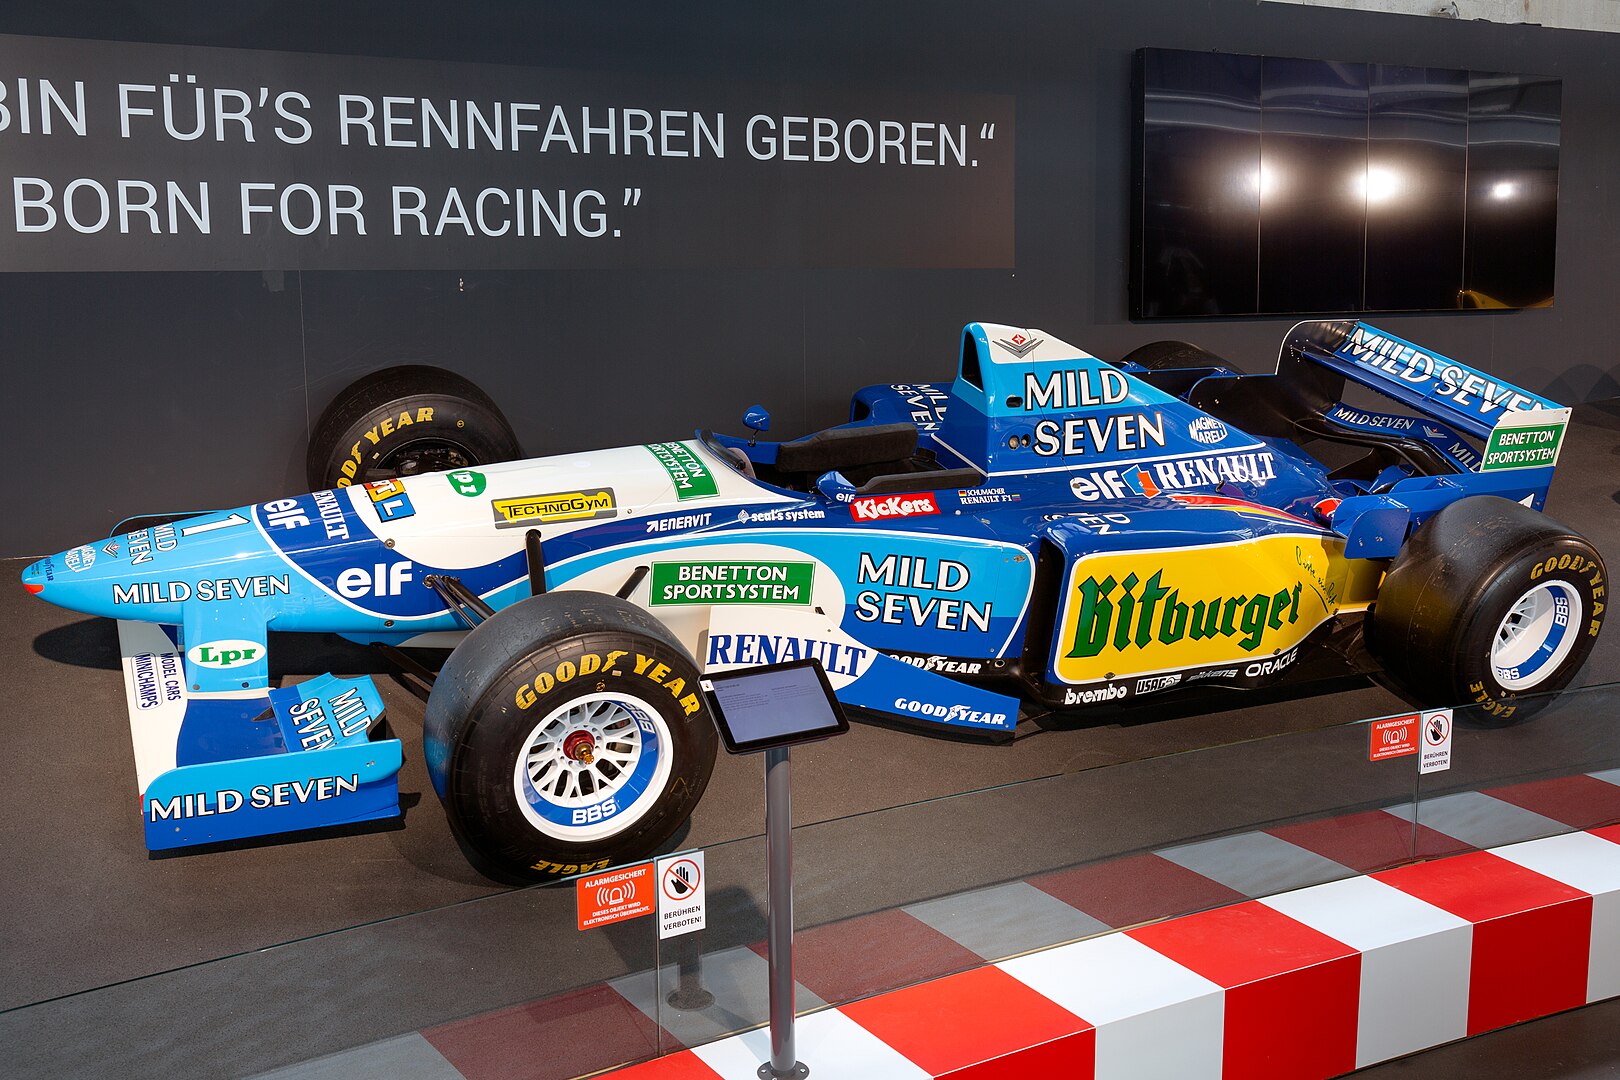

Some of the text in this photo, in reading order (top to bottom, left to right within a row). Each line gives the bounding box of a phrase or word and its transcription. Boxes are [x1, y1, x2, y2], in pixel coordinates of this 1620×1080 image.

[118, 72, 313, 144] FÜR’S
[339, 94, 725, 158] RENNFAHREN
[13, 177, 642, 238] BORN FOR RACING.”
[1342, 326, 1436, 383] MILD
[1024, 368, 1130, 412] MILD
[890, 384, 940, 431] SEVEN
[1333, 408, 1415, 430] MILD SEVEN
[363, 407, 434, 446] YEAR
[1033, 411, 1166, 457] SEVEN
[1498, 430, 1555, 447] BENETTON
[1486, 447, 1555, 466] SPORTSYSTEM
[966, 488, 1006, 497] SCHUMACHER
[1069, 452, 1276, 501] elf RENAULT
[263, 498, 311, 530] elf
[835, 493, 855, 503] elf
[960, 495, 1000, 504] RENAULT
[181, 512, 250, 537] 1
[311, 489, 350, 540] ENAULT
[785, 509, 825, 522] system
[336, 561, 412, 599] elf
[678, 566, 788, 582] BENETTON
[856, 552, 970, 591] MILD
[112, 573, 290, 605] MILD SEVEN
[662, 583, 800, 601] SPORTSYSTEM
[1530, 553, 1605, 637] GOOD YEAR
[854, 590, 993, 633] SEVEN
[1064, 568, 1303, 658] Bitburger
[1555, 596, 1569, 627] BBS
[199, 646, 257, 666] Lpr
[706, 634, 867, 678] RENAULT
[1244, 648, 1299, 678] ORACLE
[134, 653, 159, 708] MINICHAMPS
[159, 652, 181, 701] MODEL CARS
[515, 653, 700, 717] GOOD YEAR
[1136, 676, 1168, 694] USAG
[1064, 682, 1128, 705] brembo
[1469, 680, 1517, 719] EAGLE
[328, 687, 372, 738] MILD
[1423, 750, 1449, 760] BERÜHREN
[149, 774, 359, 822] MILD SEVEN
[572, 797, 617, 825] BBS
[529, 859, 610, 875] EAGLE
[584, 868, 647, 889] ALARMGESICHERT
[663, 915, 702, 931] VERBOTEN!
[664, 905, 701, 920] BERÜHREN
